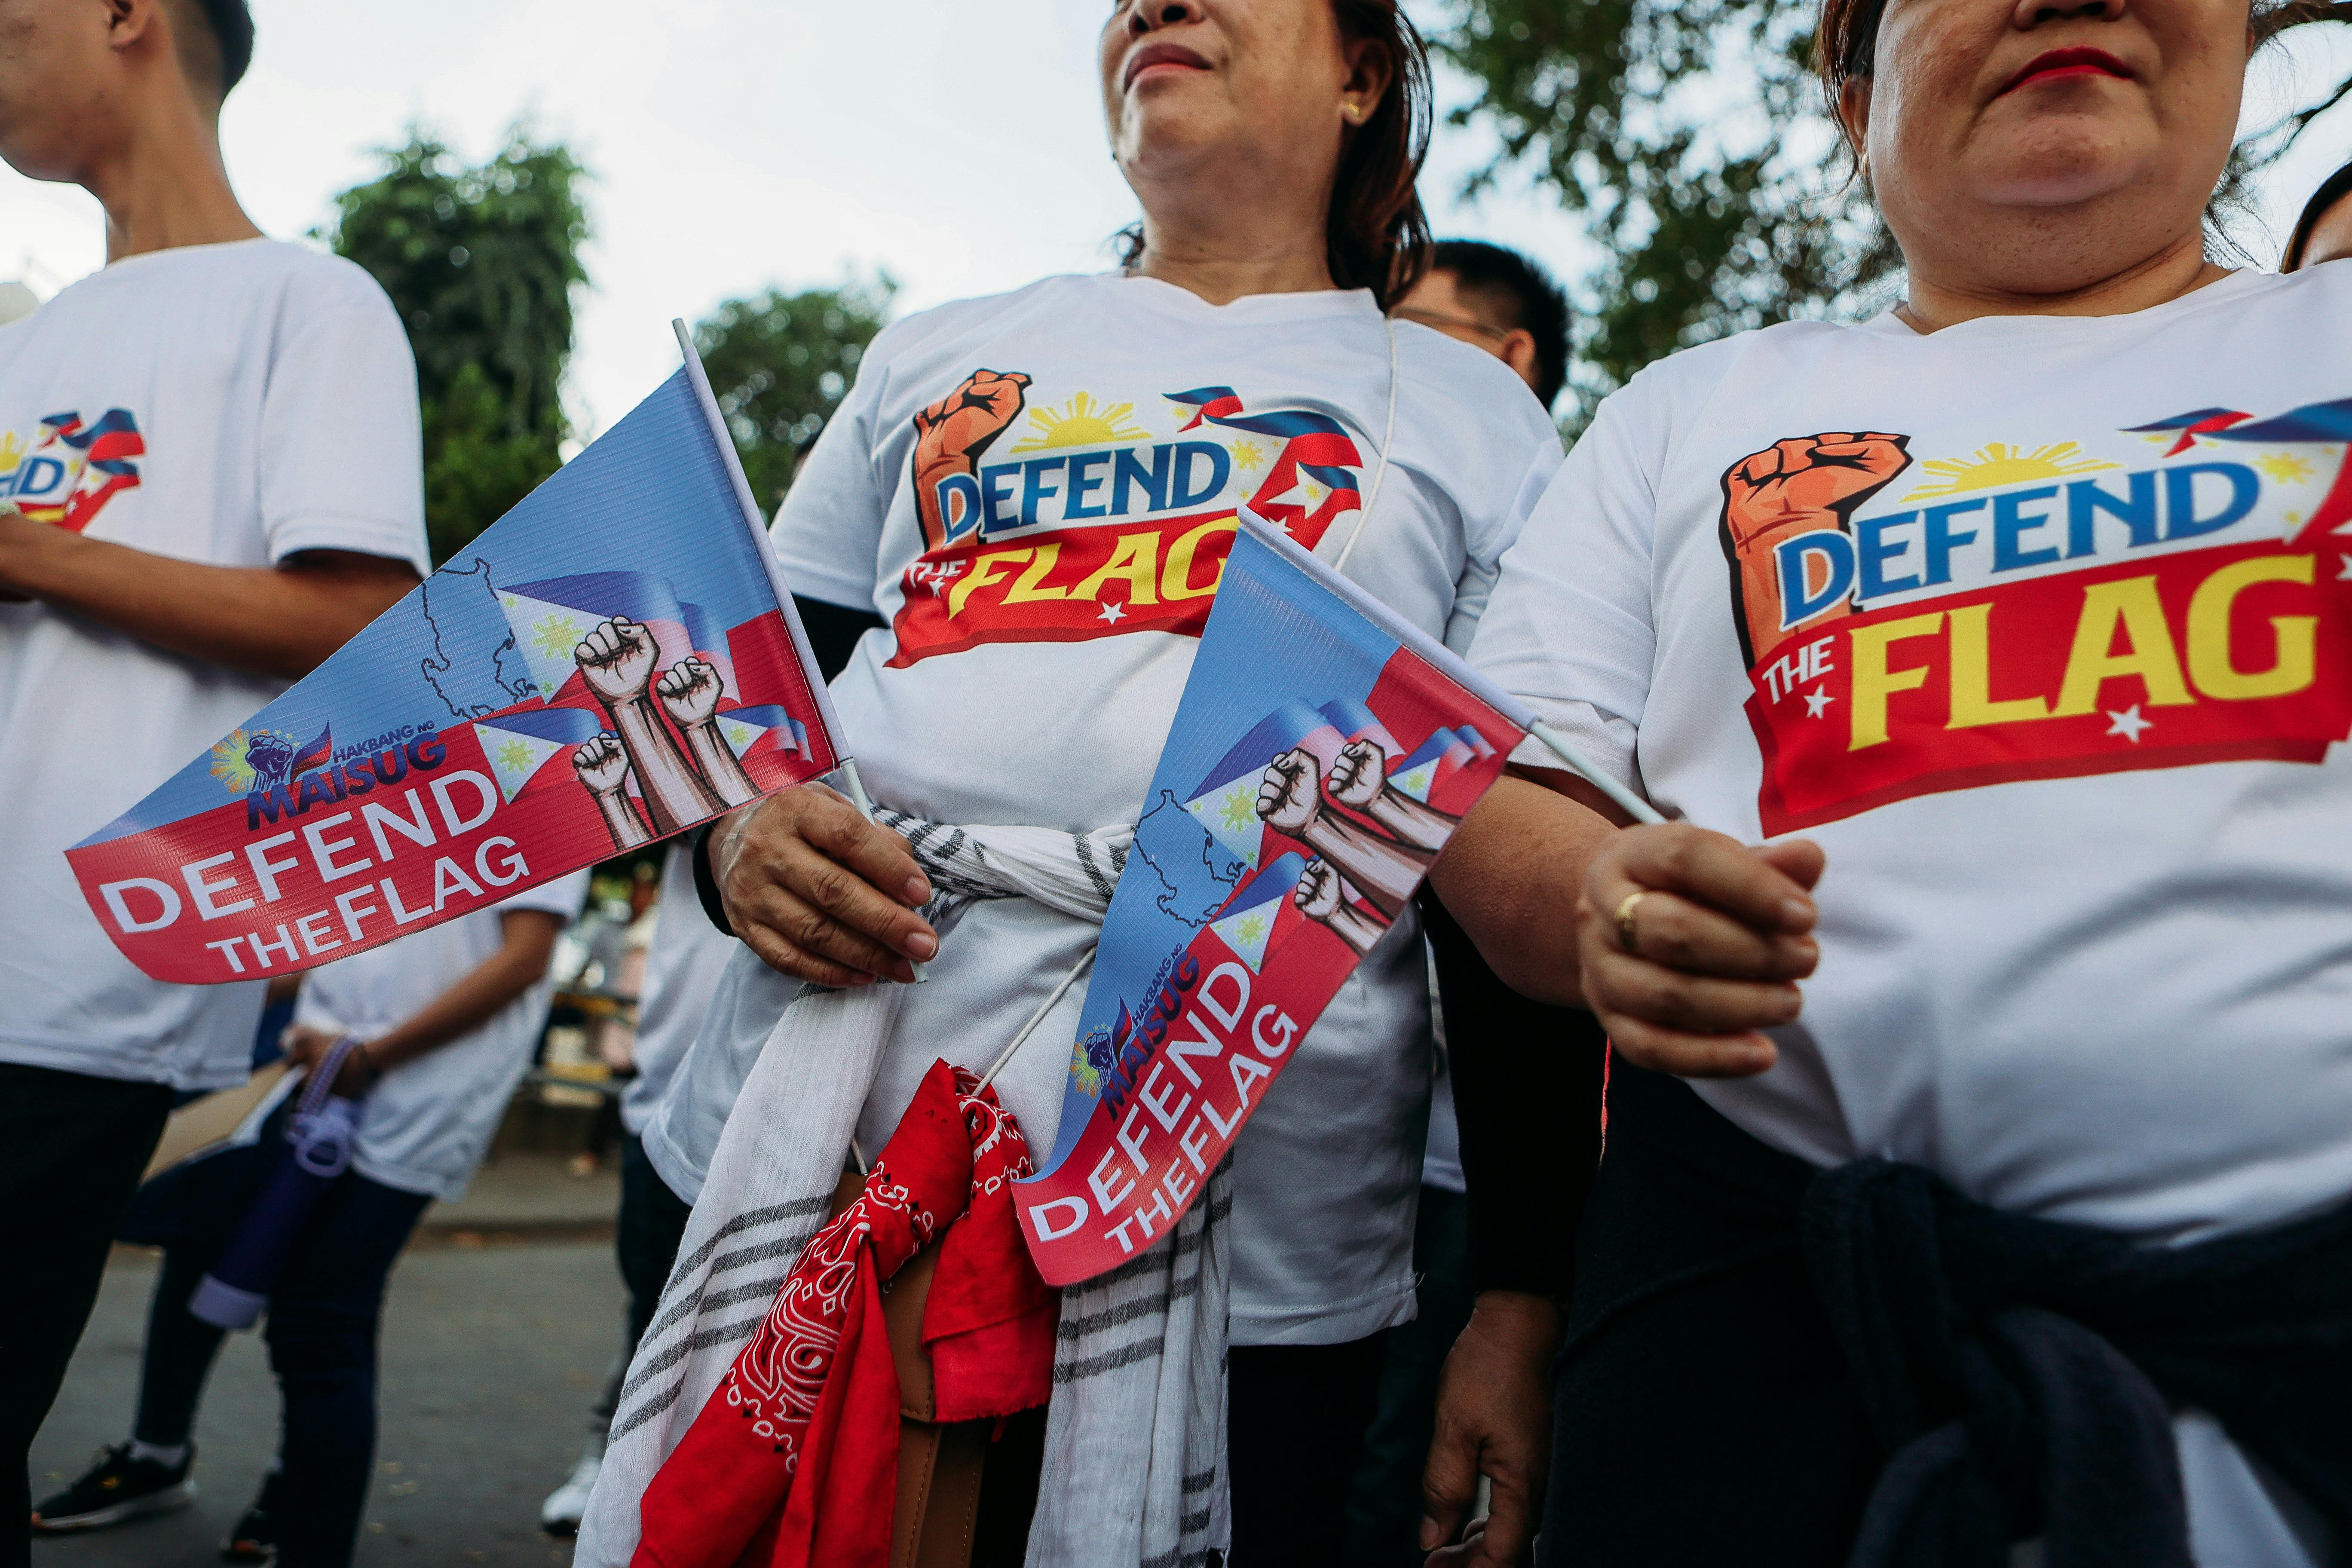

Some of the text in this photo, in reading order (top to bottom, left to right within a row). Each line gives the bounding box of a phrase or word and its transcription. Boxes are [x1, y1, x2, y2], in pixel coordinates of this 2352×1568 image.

[937, 441, 1231, 544] DEFEND
[1776, 462, 2260, 630] DEFEND
[904, 516, 1241, 621] THE FLAG
[1762, 554, 2319, 752] THE FLAG
[248, 732, 447, 831] MAISUG
[333, 720, 435, 763] HAKBANG NG
[100, 770, 498, 934] DEFEND
[1101, 952, 1200, 1121] MAISUG
[1132, 943, 1183, 1026] HAKBANG NG
[1029, 962, 1251, 1243] DEFEND
